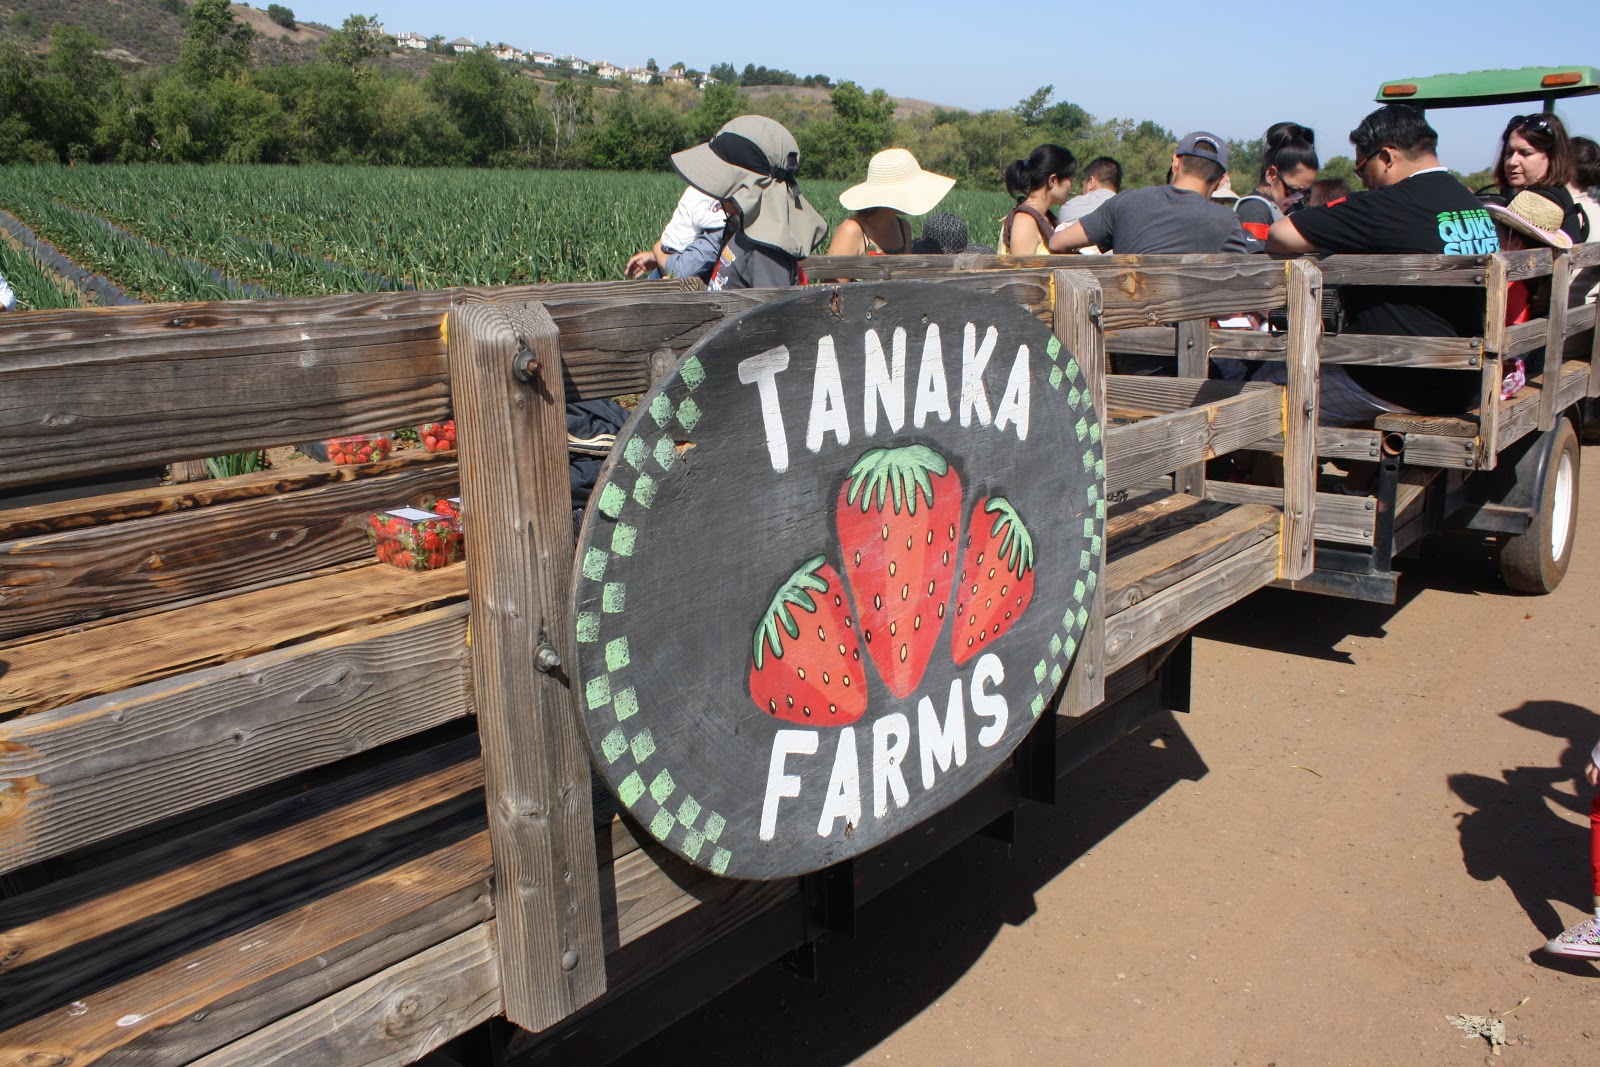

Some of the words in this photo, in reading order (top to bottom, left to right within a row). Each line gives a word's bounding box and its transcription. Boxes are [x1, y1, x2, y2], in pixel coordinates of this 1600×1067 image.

[1437, 214, 1497, 243] QUIK
[737, 321, 1031, 473] TANAKA
[759, 652, 1009, 842] FARMS
